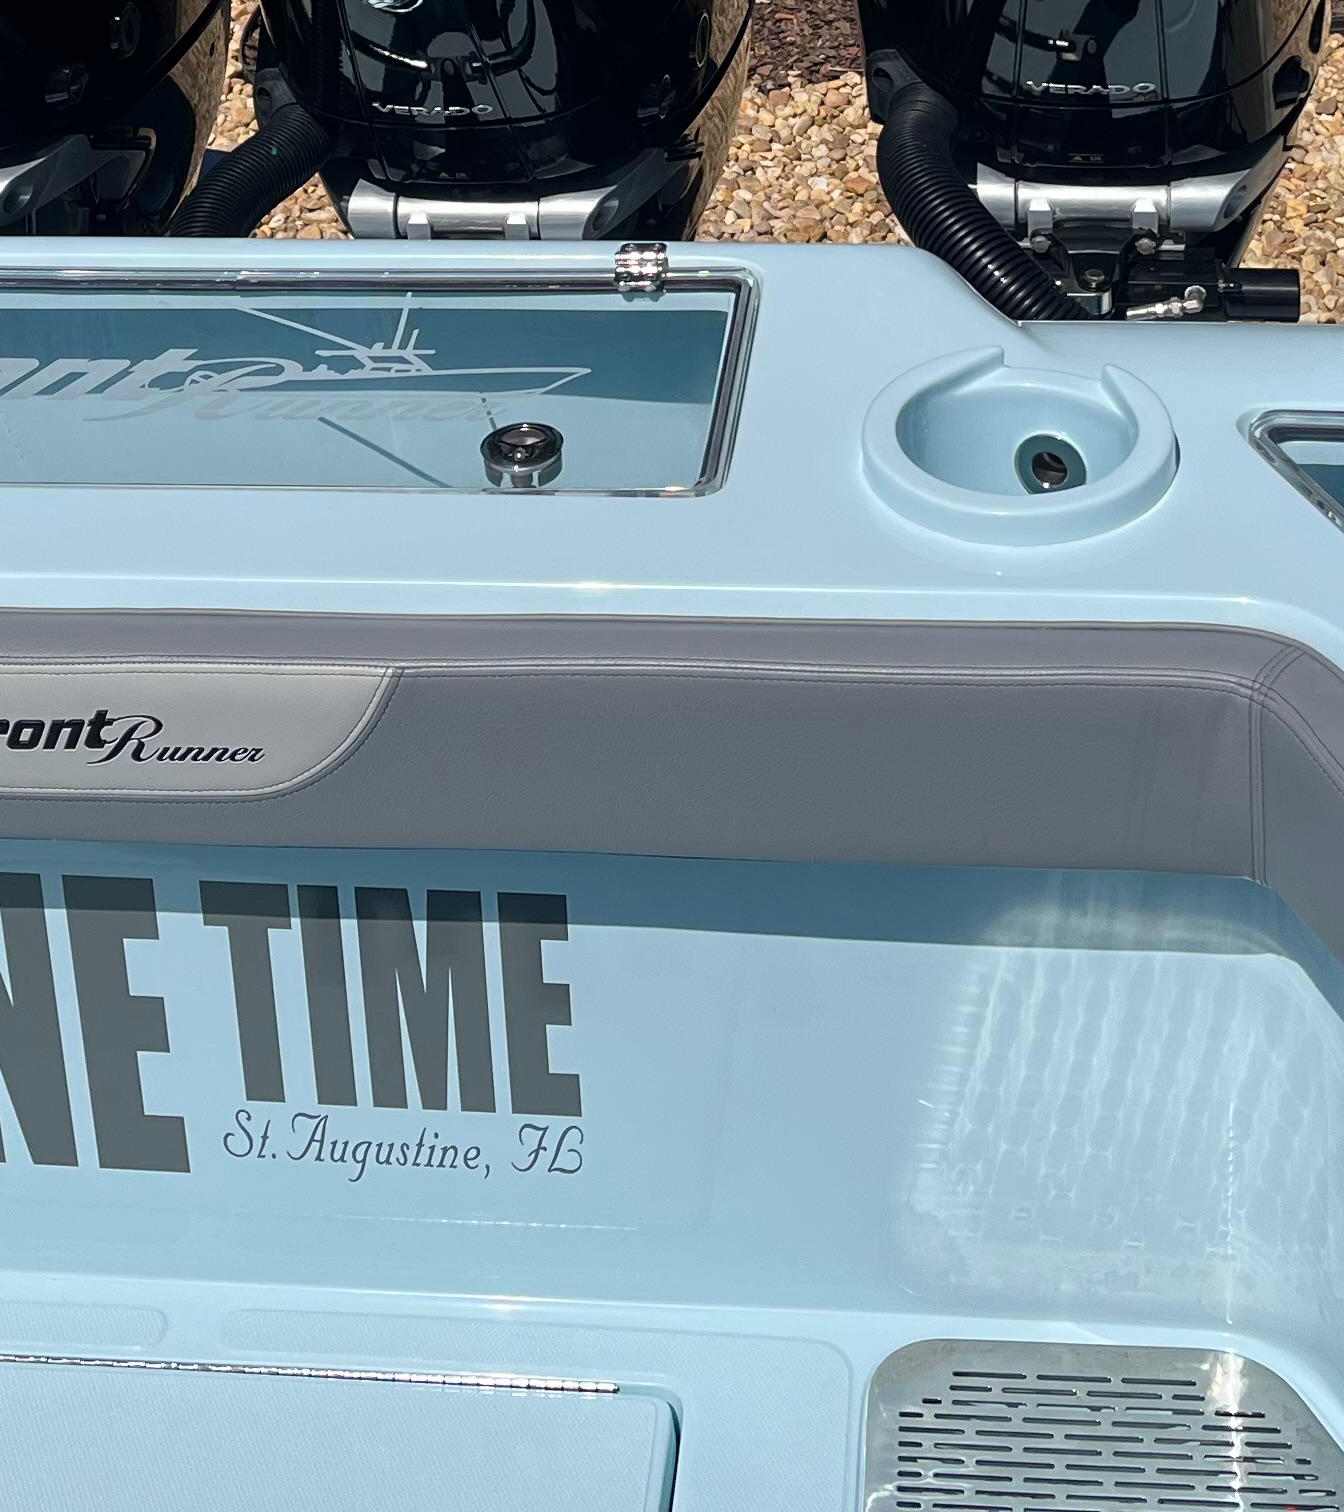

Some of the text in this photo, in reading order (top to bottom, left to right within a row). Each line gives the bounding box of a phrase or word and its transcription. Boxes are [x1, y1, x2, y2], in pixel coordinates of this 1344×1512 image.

[371, 102, 494, 117] VERADO
[1025, 79, 1157, 97] VERADO
[86, 714, 266, 766] Runner
[198, 879, 583, 1118] TIME
[222, 1108, 278, 1160] St.
[285, 1112, 492, 1184] Augustine,
